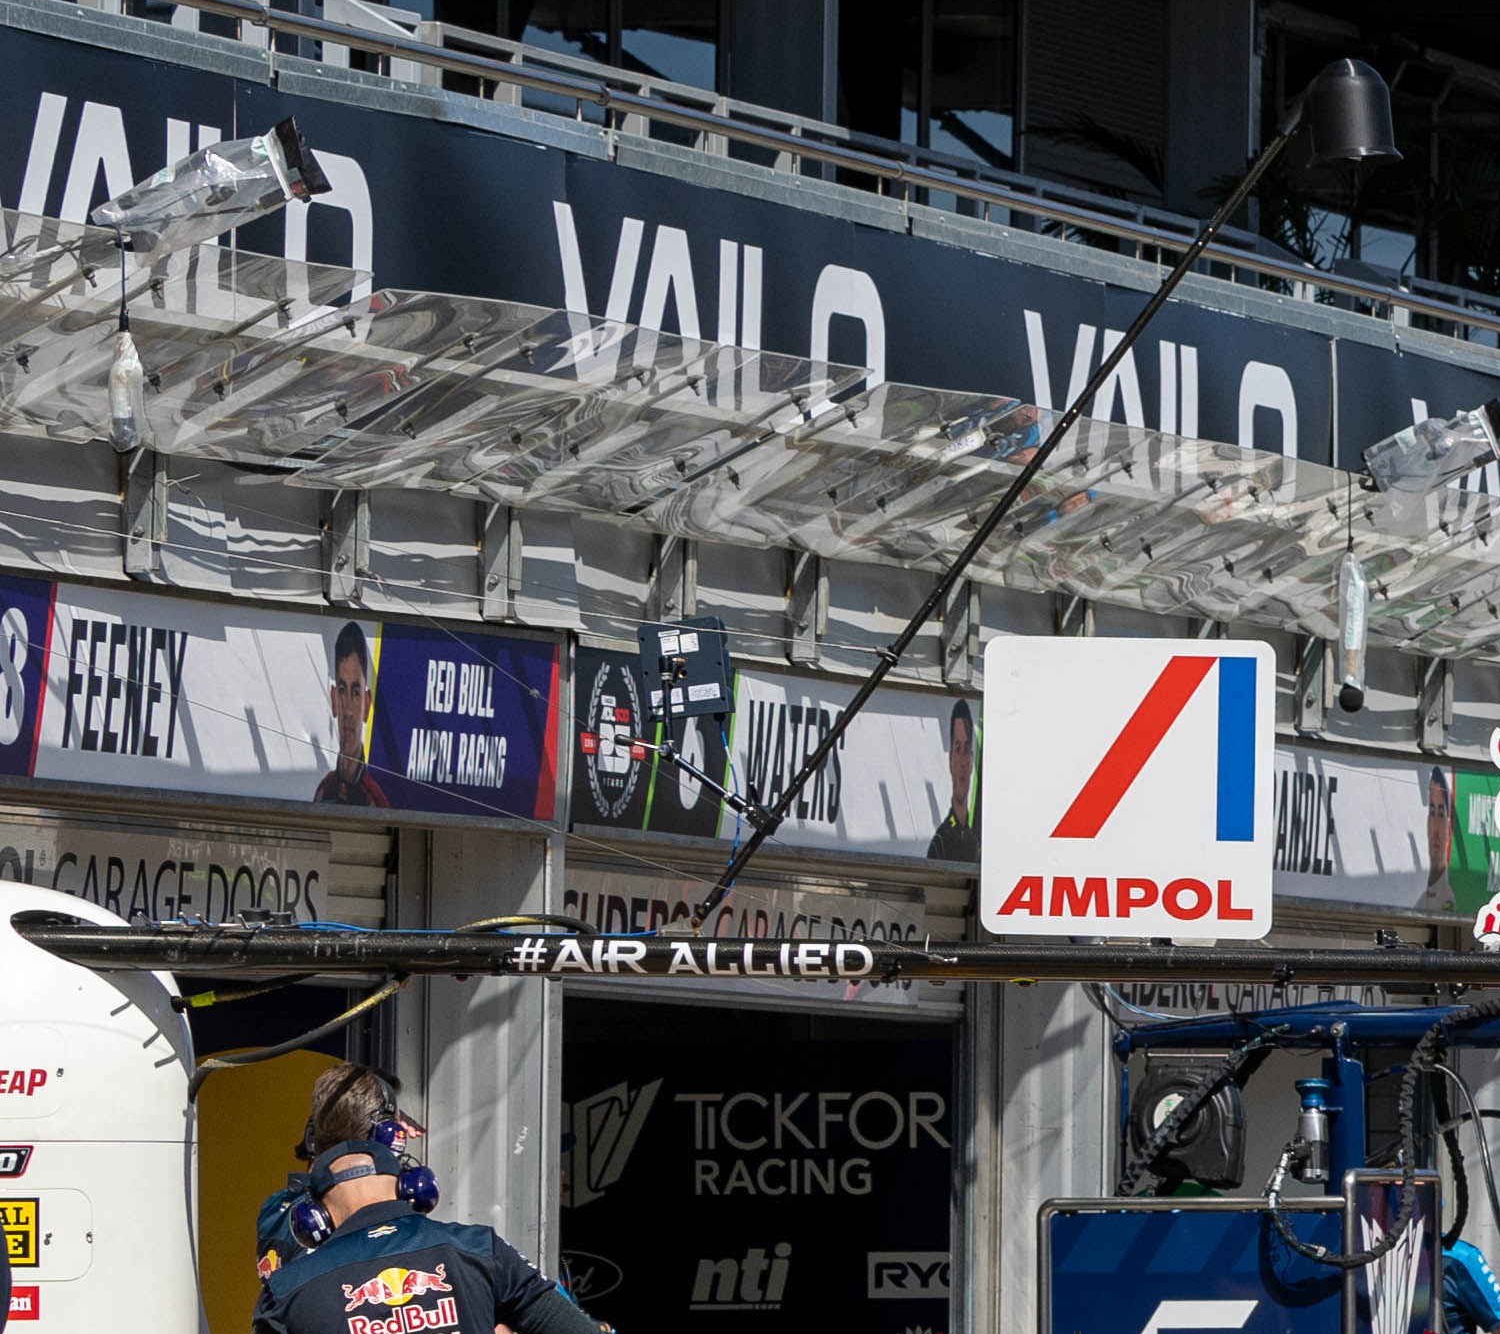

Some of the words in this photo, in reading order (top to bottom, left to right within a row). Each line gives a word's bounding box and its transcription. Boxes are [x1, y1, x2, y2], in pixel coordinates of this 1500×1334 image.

[553, 200, 887, 445] VAILO
[1024, 310, 1298, 505] VAILO
[62, 619, 188, 759] FEENEY
[425, 658, 455, 713] RED
[457, 663, 495, 718] BULL
[406, 727, 454, 783] AMPOL
[455, 731, 507, 789] RACING
[750, 699, 846, 824] WATERS
[1276, 765, 1338, 873] ANDLE
[52, 852, 195, 923] GARAGE
[997, 877, 1254, 921] AMPOL
[512, 938, 648, 974] #AIR
[667, 942, 875, 977] ALLIED
[694, 1158, 873, 1196] RACING
[691, 1241, 793, 1303] nti
